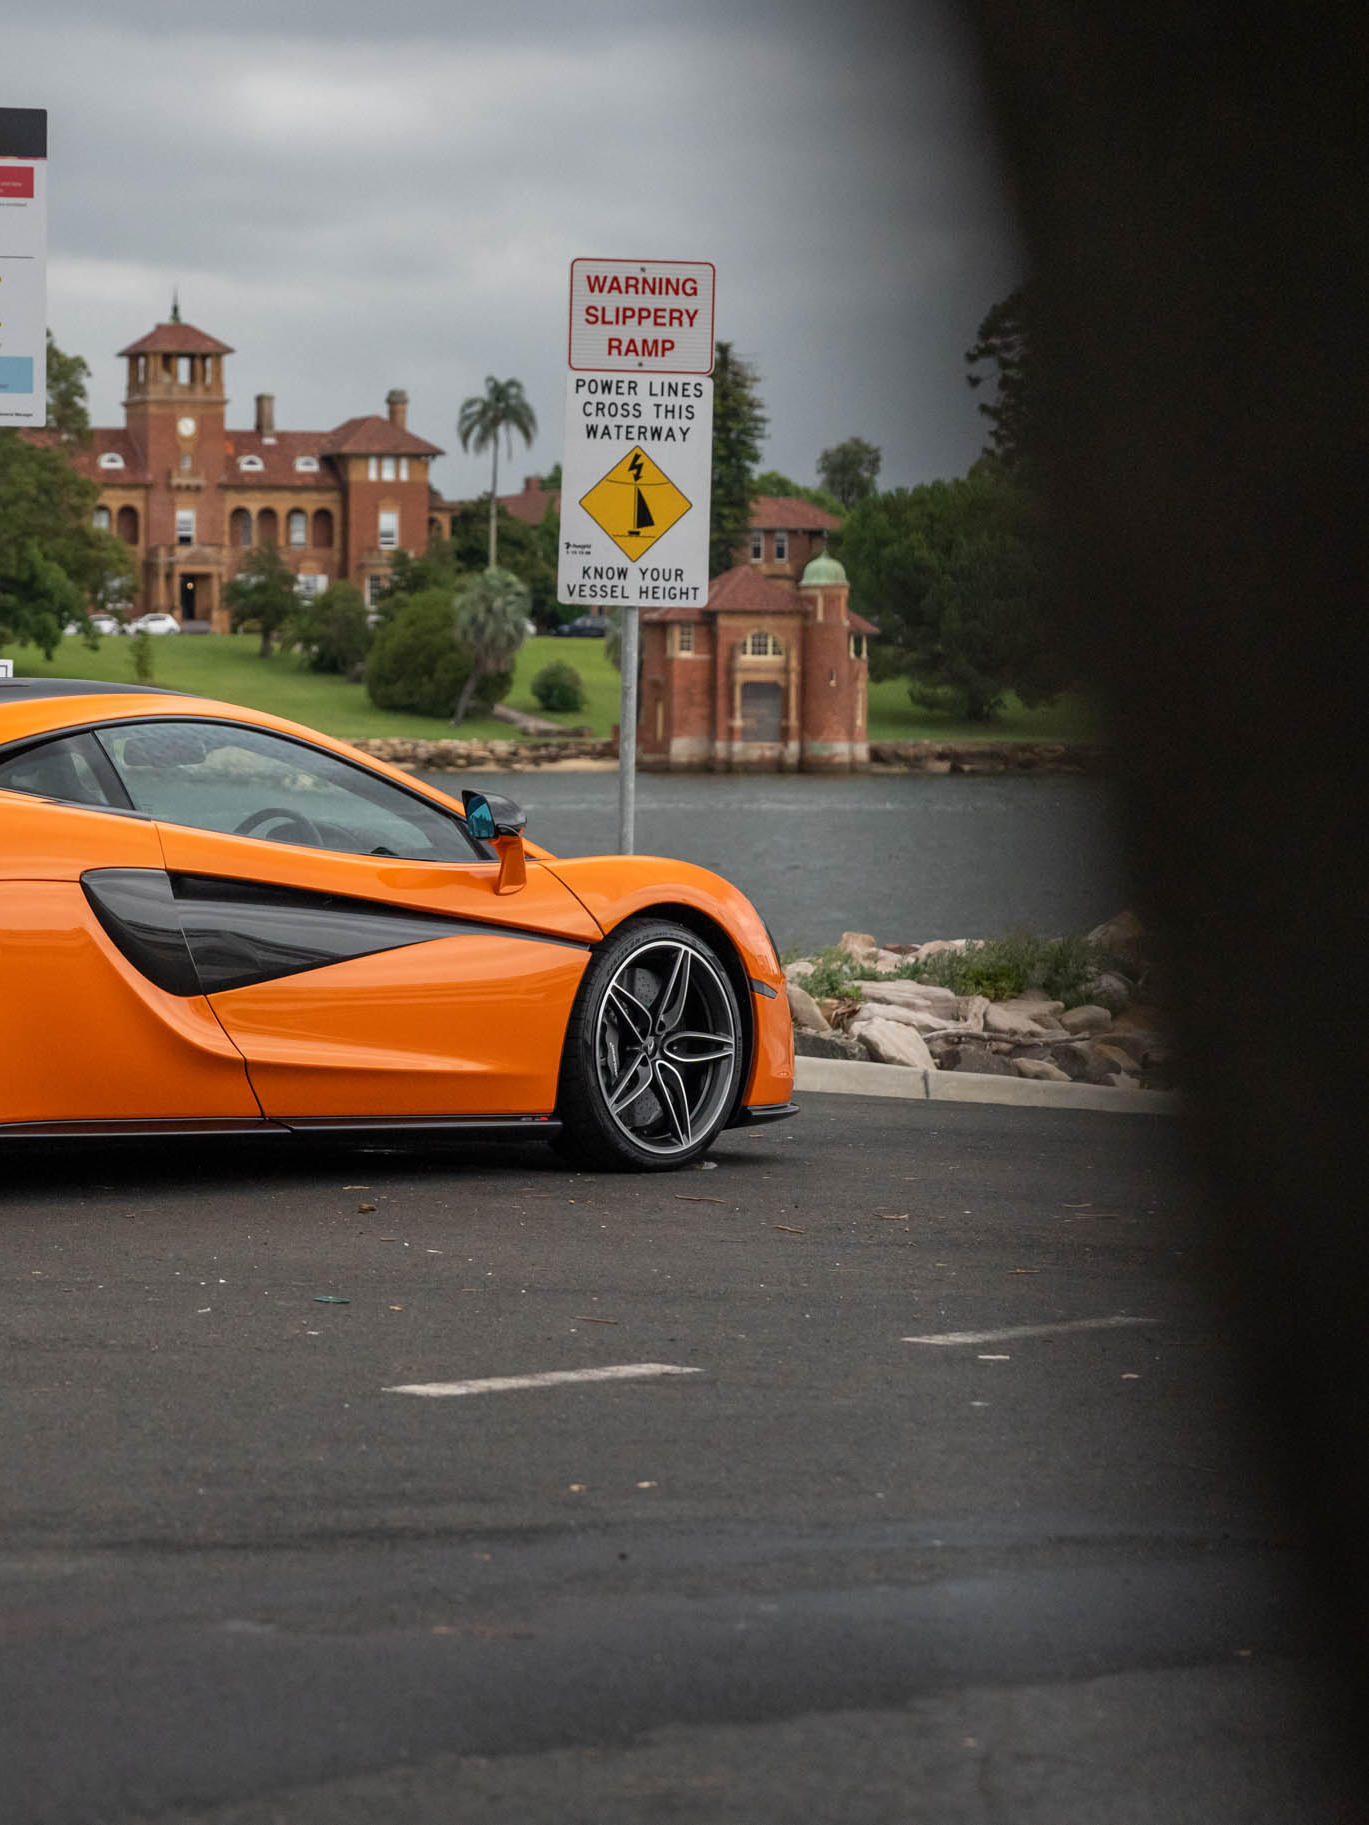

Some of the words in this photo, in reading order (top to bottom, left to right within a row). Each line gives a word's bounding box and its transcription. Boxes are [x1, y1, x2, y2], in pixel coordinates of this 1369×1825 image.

[586, 275, 698, 297] WARNING
[584, 306, 699, 328] SLIPPERY
[607, 338, 675, 358] RAMP
[575, 378, 638, 396] POWER
[649, 381, 703, 398] LINES
[582, 401, 642, 418] CROSS
[653, 404, 695, 420] THIS
[586, 424, 690, 442] WATERWAY
[582, 566, 628, 580] KNOW
[639, 568, 684, 582] YOUR
[566, 584, 630, 599] VESSEL
[638, 586, 700, 601] HEIGHT
